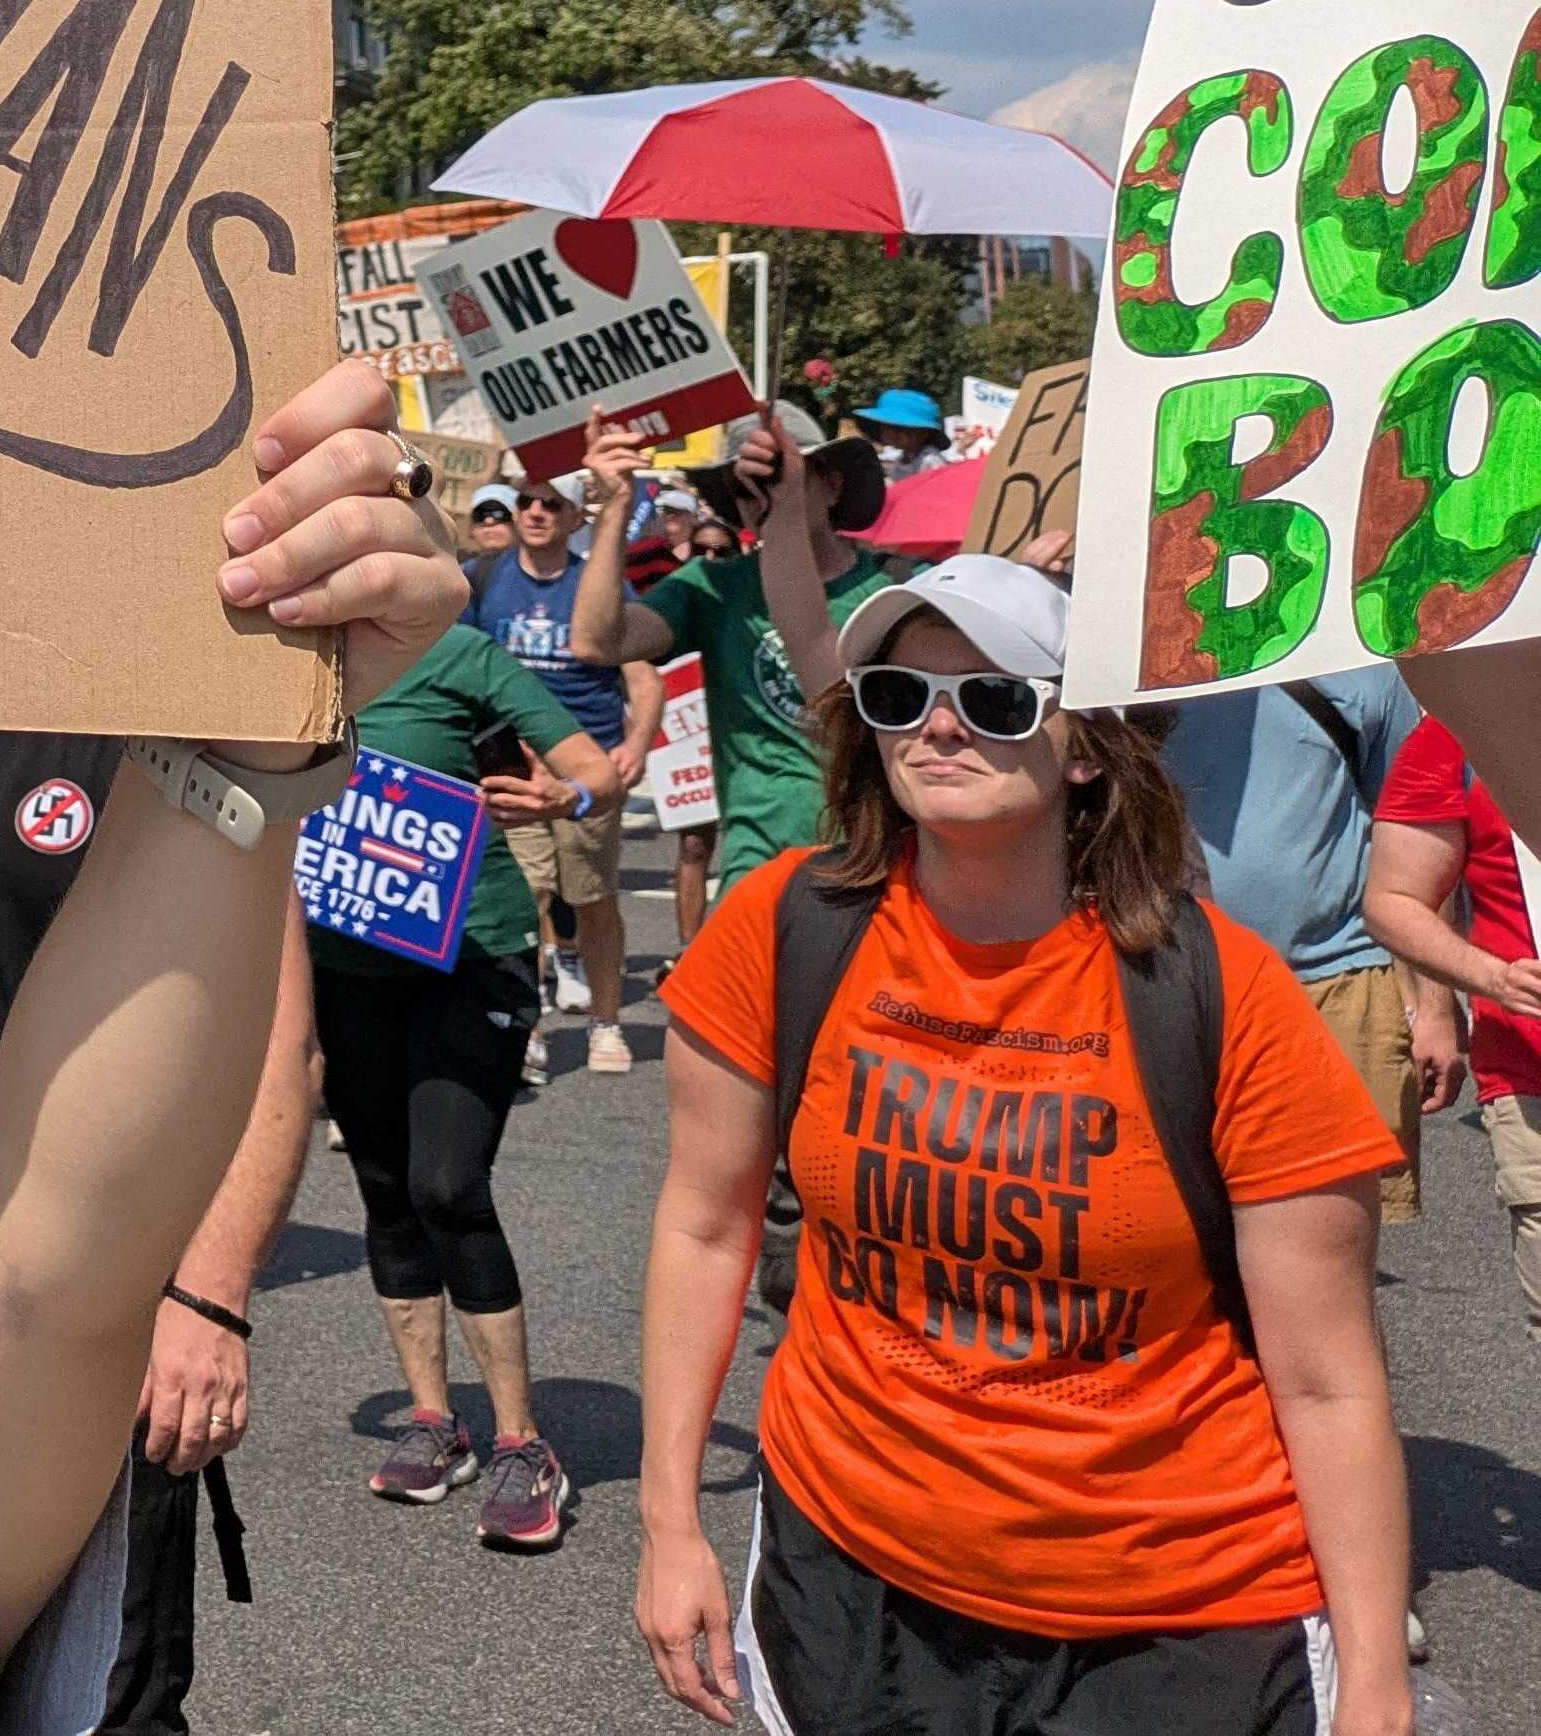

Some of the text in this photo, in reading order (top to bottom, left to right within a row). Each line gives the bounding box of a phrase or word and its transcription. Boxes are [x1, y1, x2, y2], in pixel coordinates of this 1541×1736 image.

[338, 242, 415, 295] FALL
[480, 248, 575, 334] WE
[480, 355, 558, 423] OUR
[542, 298, 710, 402] FARMERS
[321, 821, 347, 847] IN
[323, 789, 462, 861] INGS
[294, 836, 441, 923] ERICA
[328, 888, 376, 921] 1776
[868, 992, 1109, 1057] RefuseFascism.org
[844, 1045, 1117, 1188] TRUMP
[854, 1146, 1090, 1281] MUST
[820, 1217, 1148, 1363] GO NOW!
